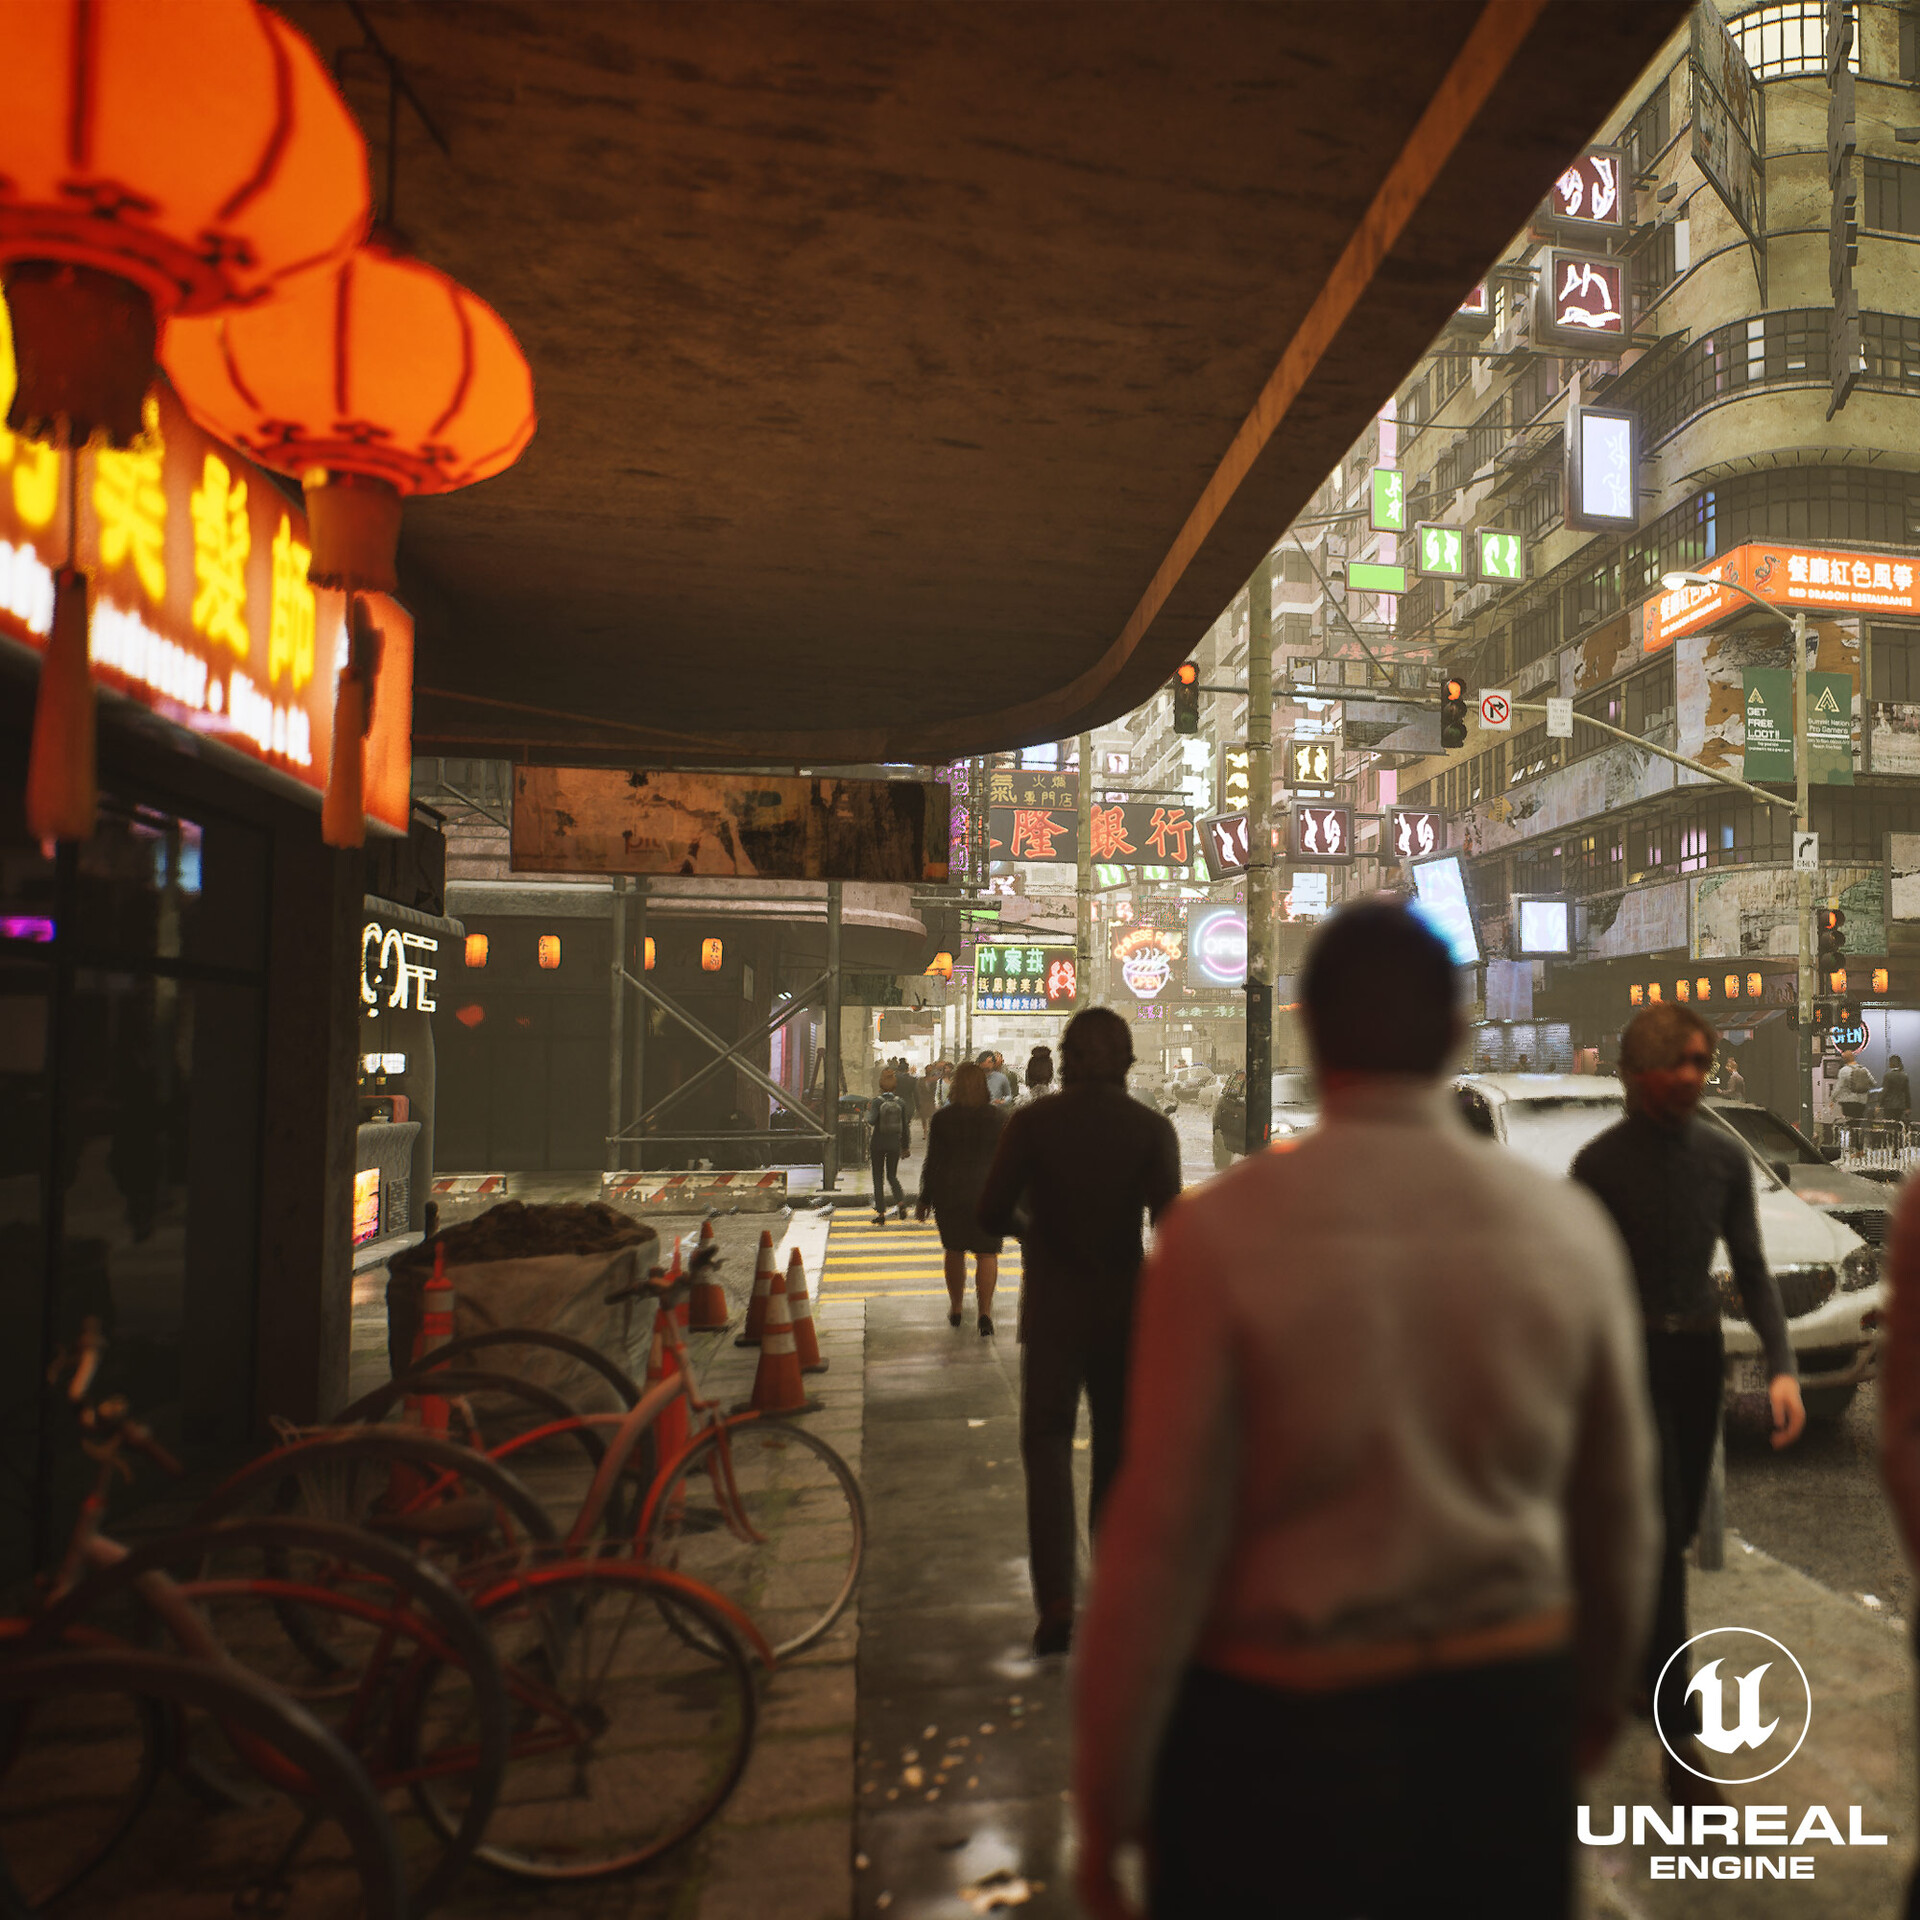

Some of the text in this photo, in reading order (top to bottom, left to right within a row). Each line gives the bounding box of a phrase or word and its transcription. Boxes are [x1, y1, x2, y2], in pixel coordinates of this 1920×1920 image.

[1788, 587, 1806, 598] RED
[1808, 589, 1849, 602] DRAGON
[1747, 707, 1767, 717] GET
[1748, 718, 1774, 729] FREE
[1796, 860, 1817, 868] ONLY
